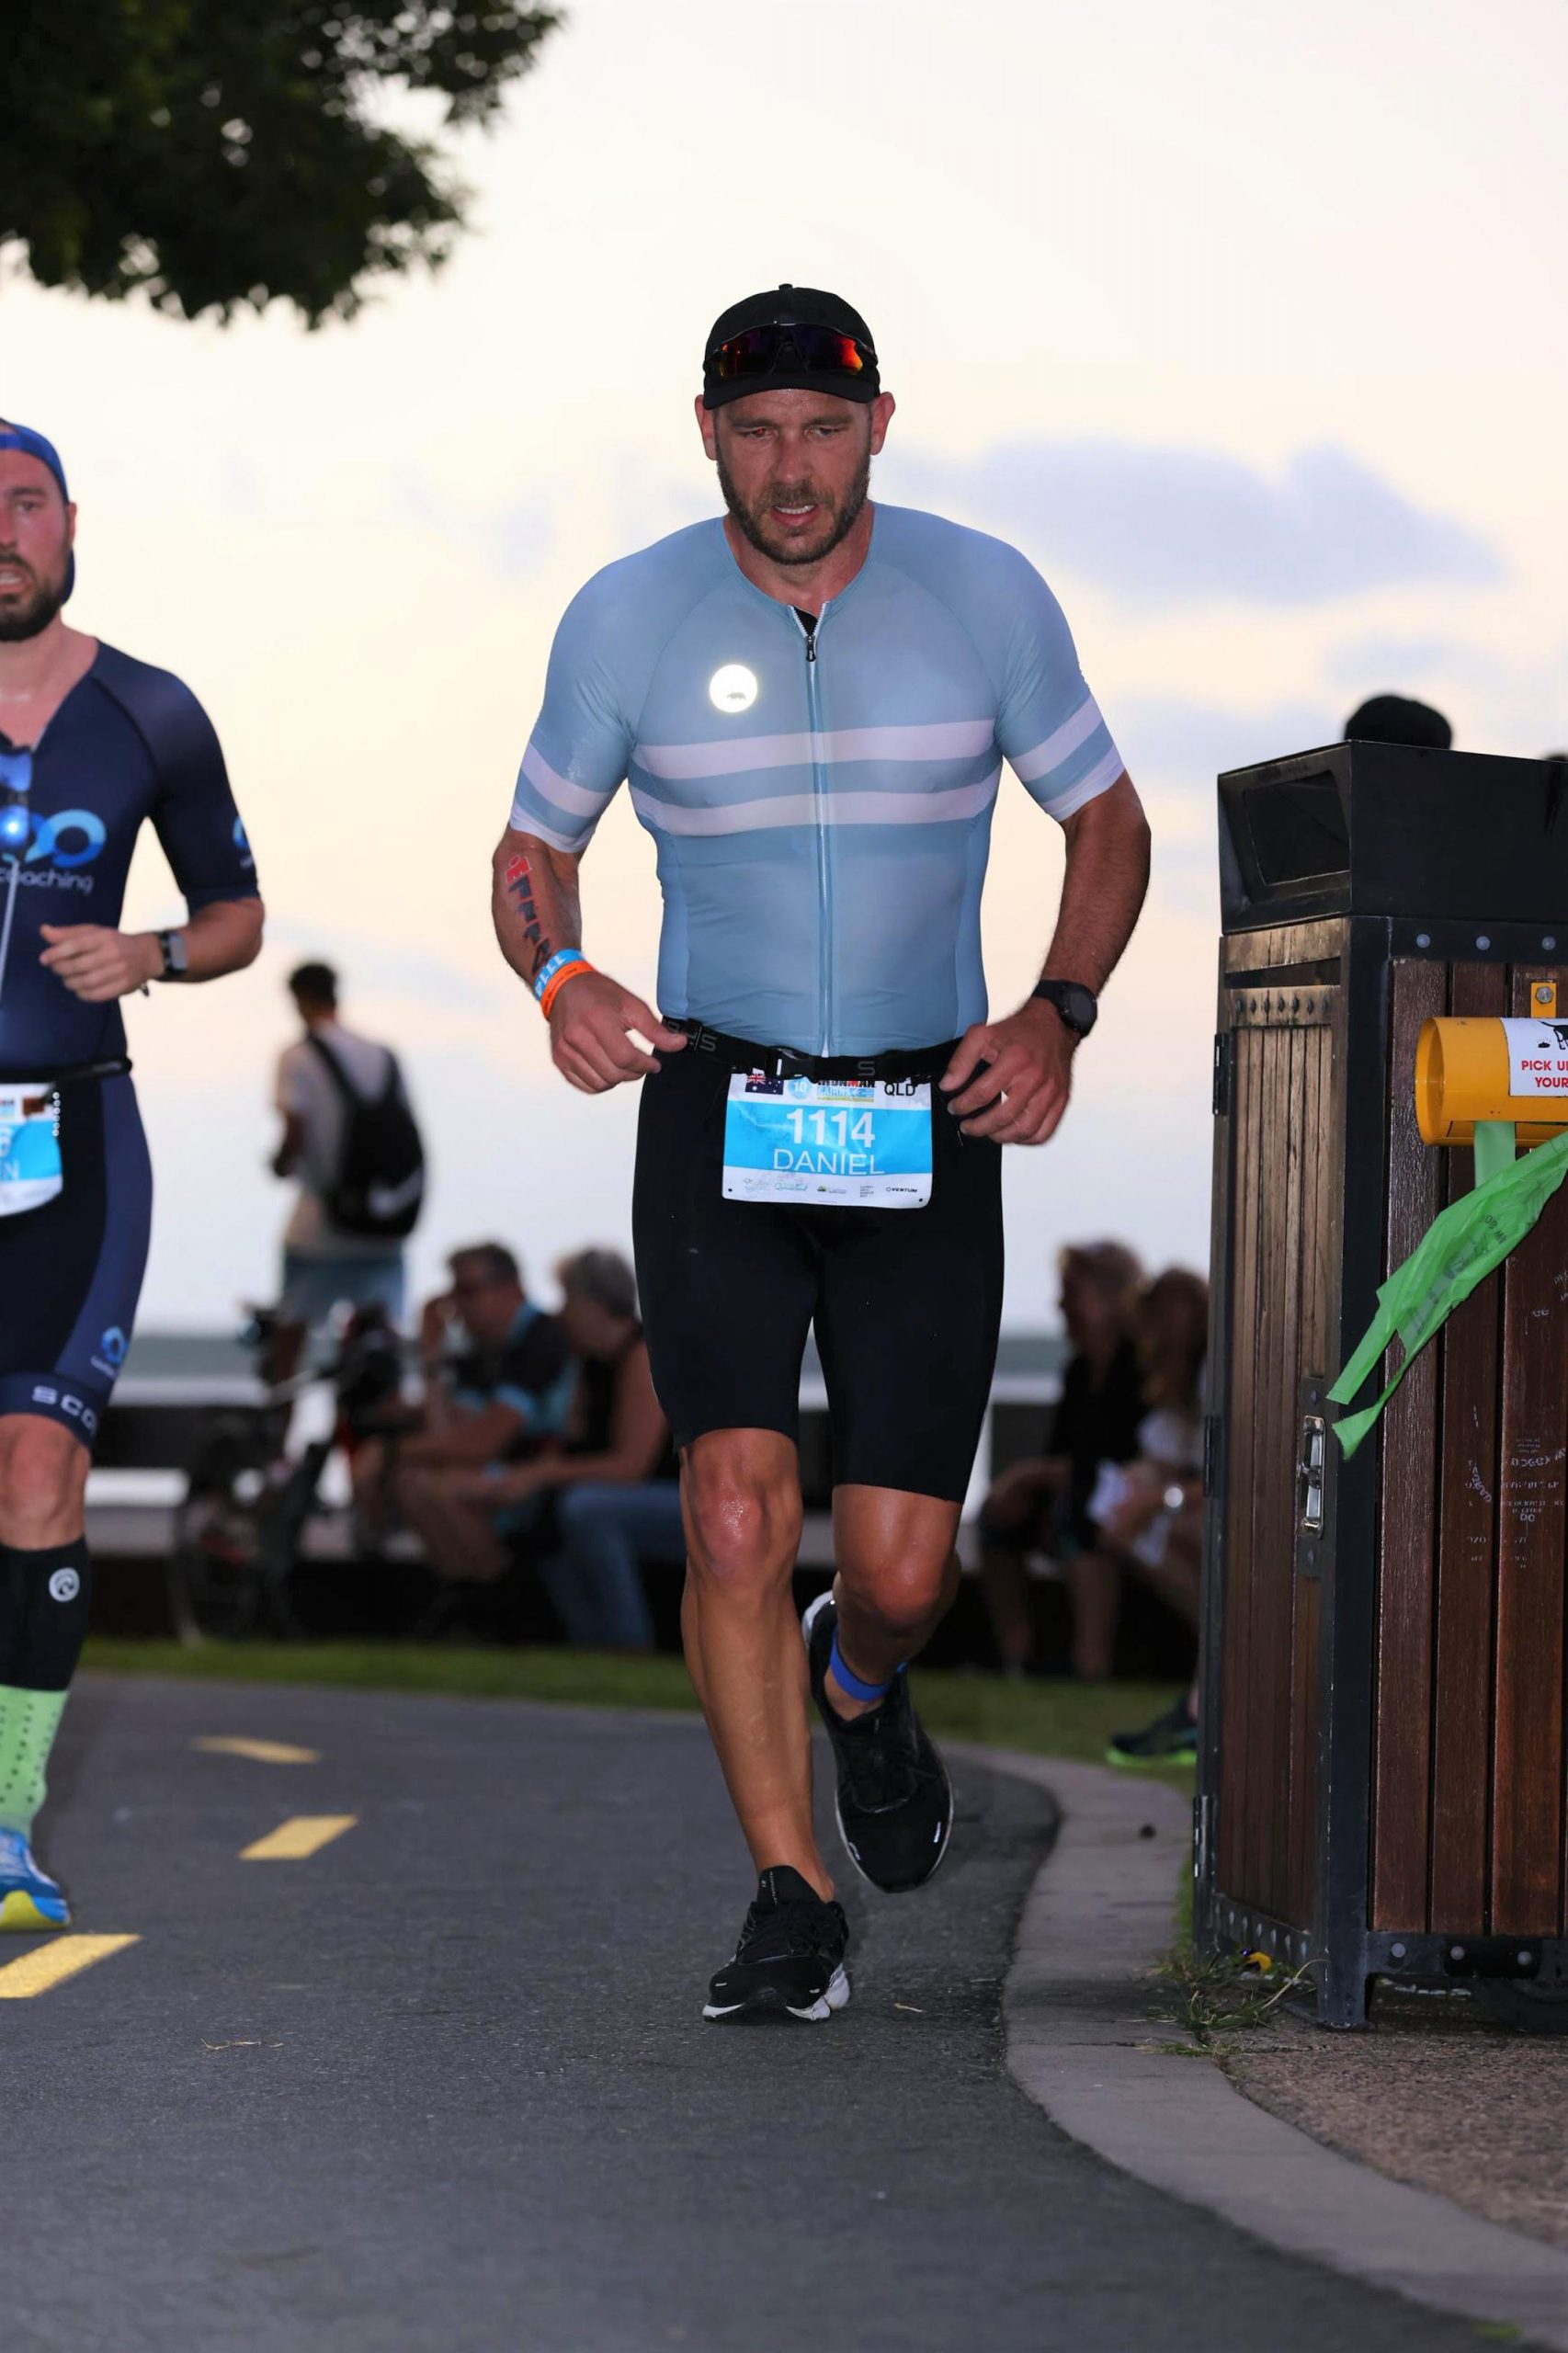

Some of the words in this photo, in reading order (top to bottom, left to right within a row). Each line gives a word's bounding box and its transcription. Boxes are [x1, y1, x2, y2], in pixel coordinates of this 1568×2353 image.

[1521, 1060, 1551, 1071] PICK
[1535, 1077, 1568, 1088] YOUR
[884, 1083, 916, 1097] QLD
[787, 1108, 876, 1148] 1114
[773, 1149, 885, 1175] DANIEL
